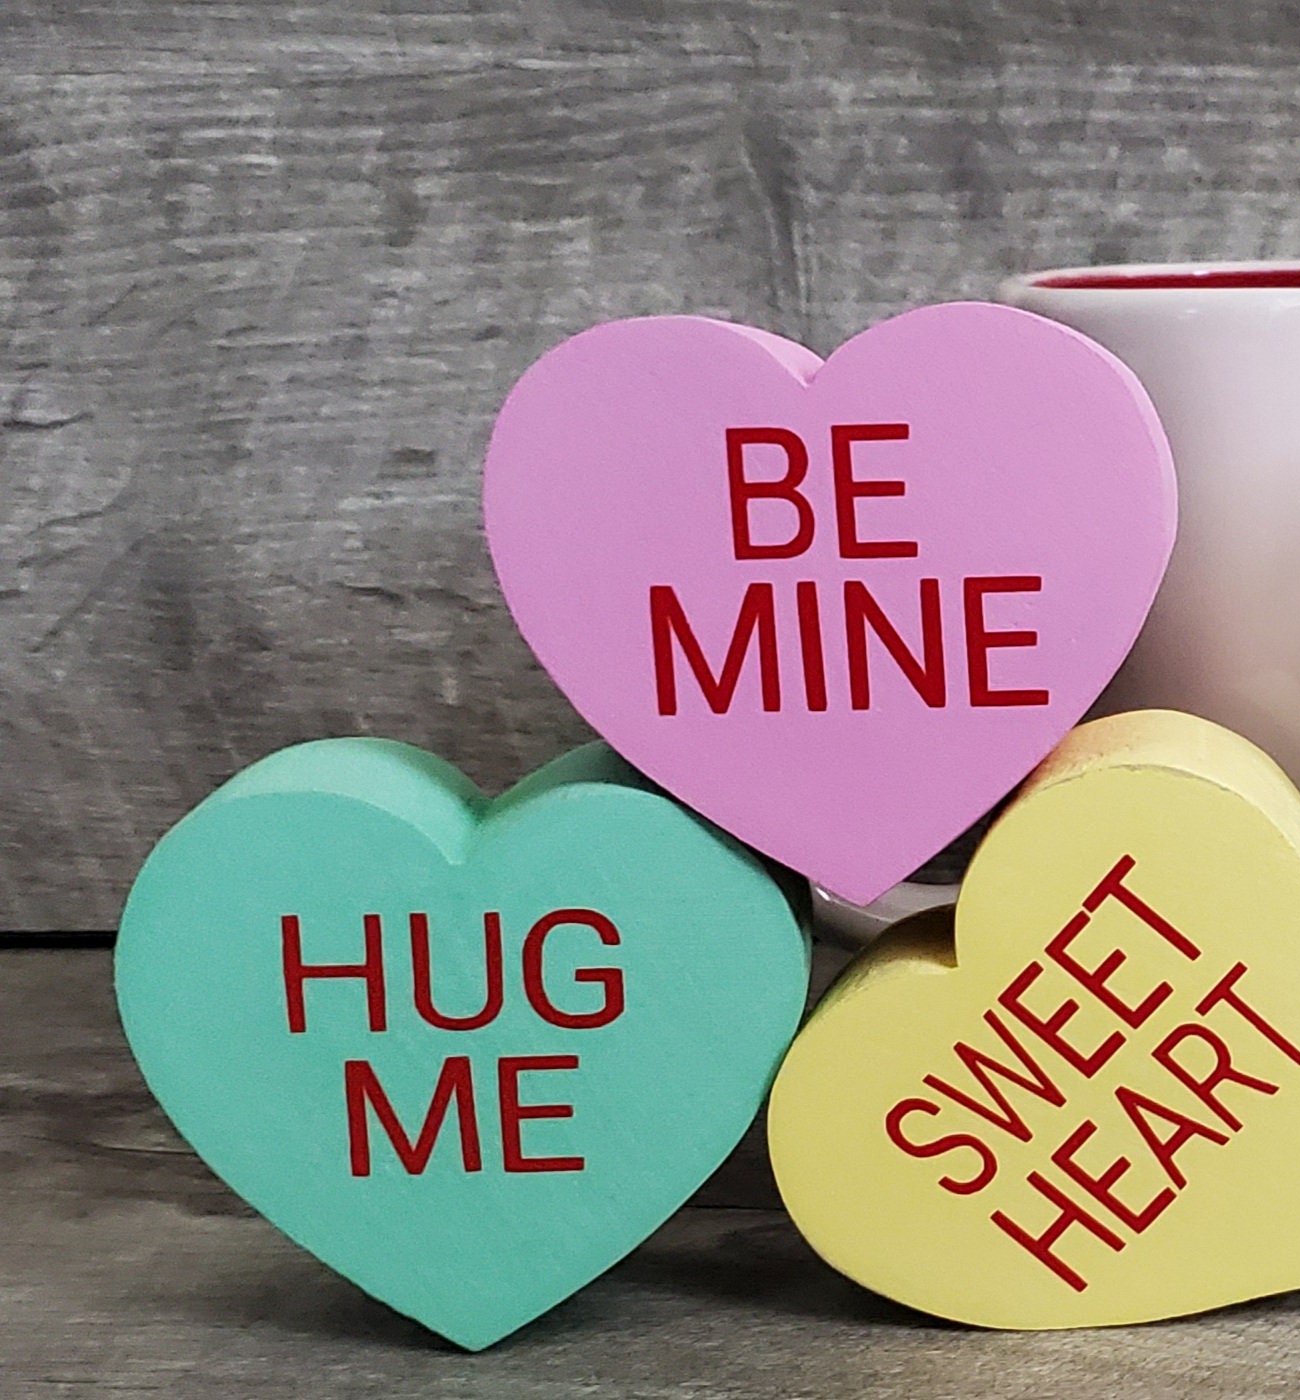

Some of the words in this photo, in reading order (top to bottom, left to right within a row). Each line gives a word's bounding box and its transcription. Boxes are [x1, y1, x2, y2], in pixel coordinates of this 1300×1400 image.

[726, 424, 919, 561] BE
[650, 576, 1050, 716] MINE
[282, 910, 625, 1032] HUG
[886, 855, 1201, 1195] SWEET
[345, 1056, 585, 1177] ME
